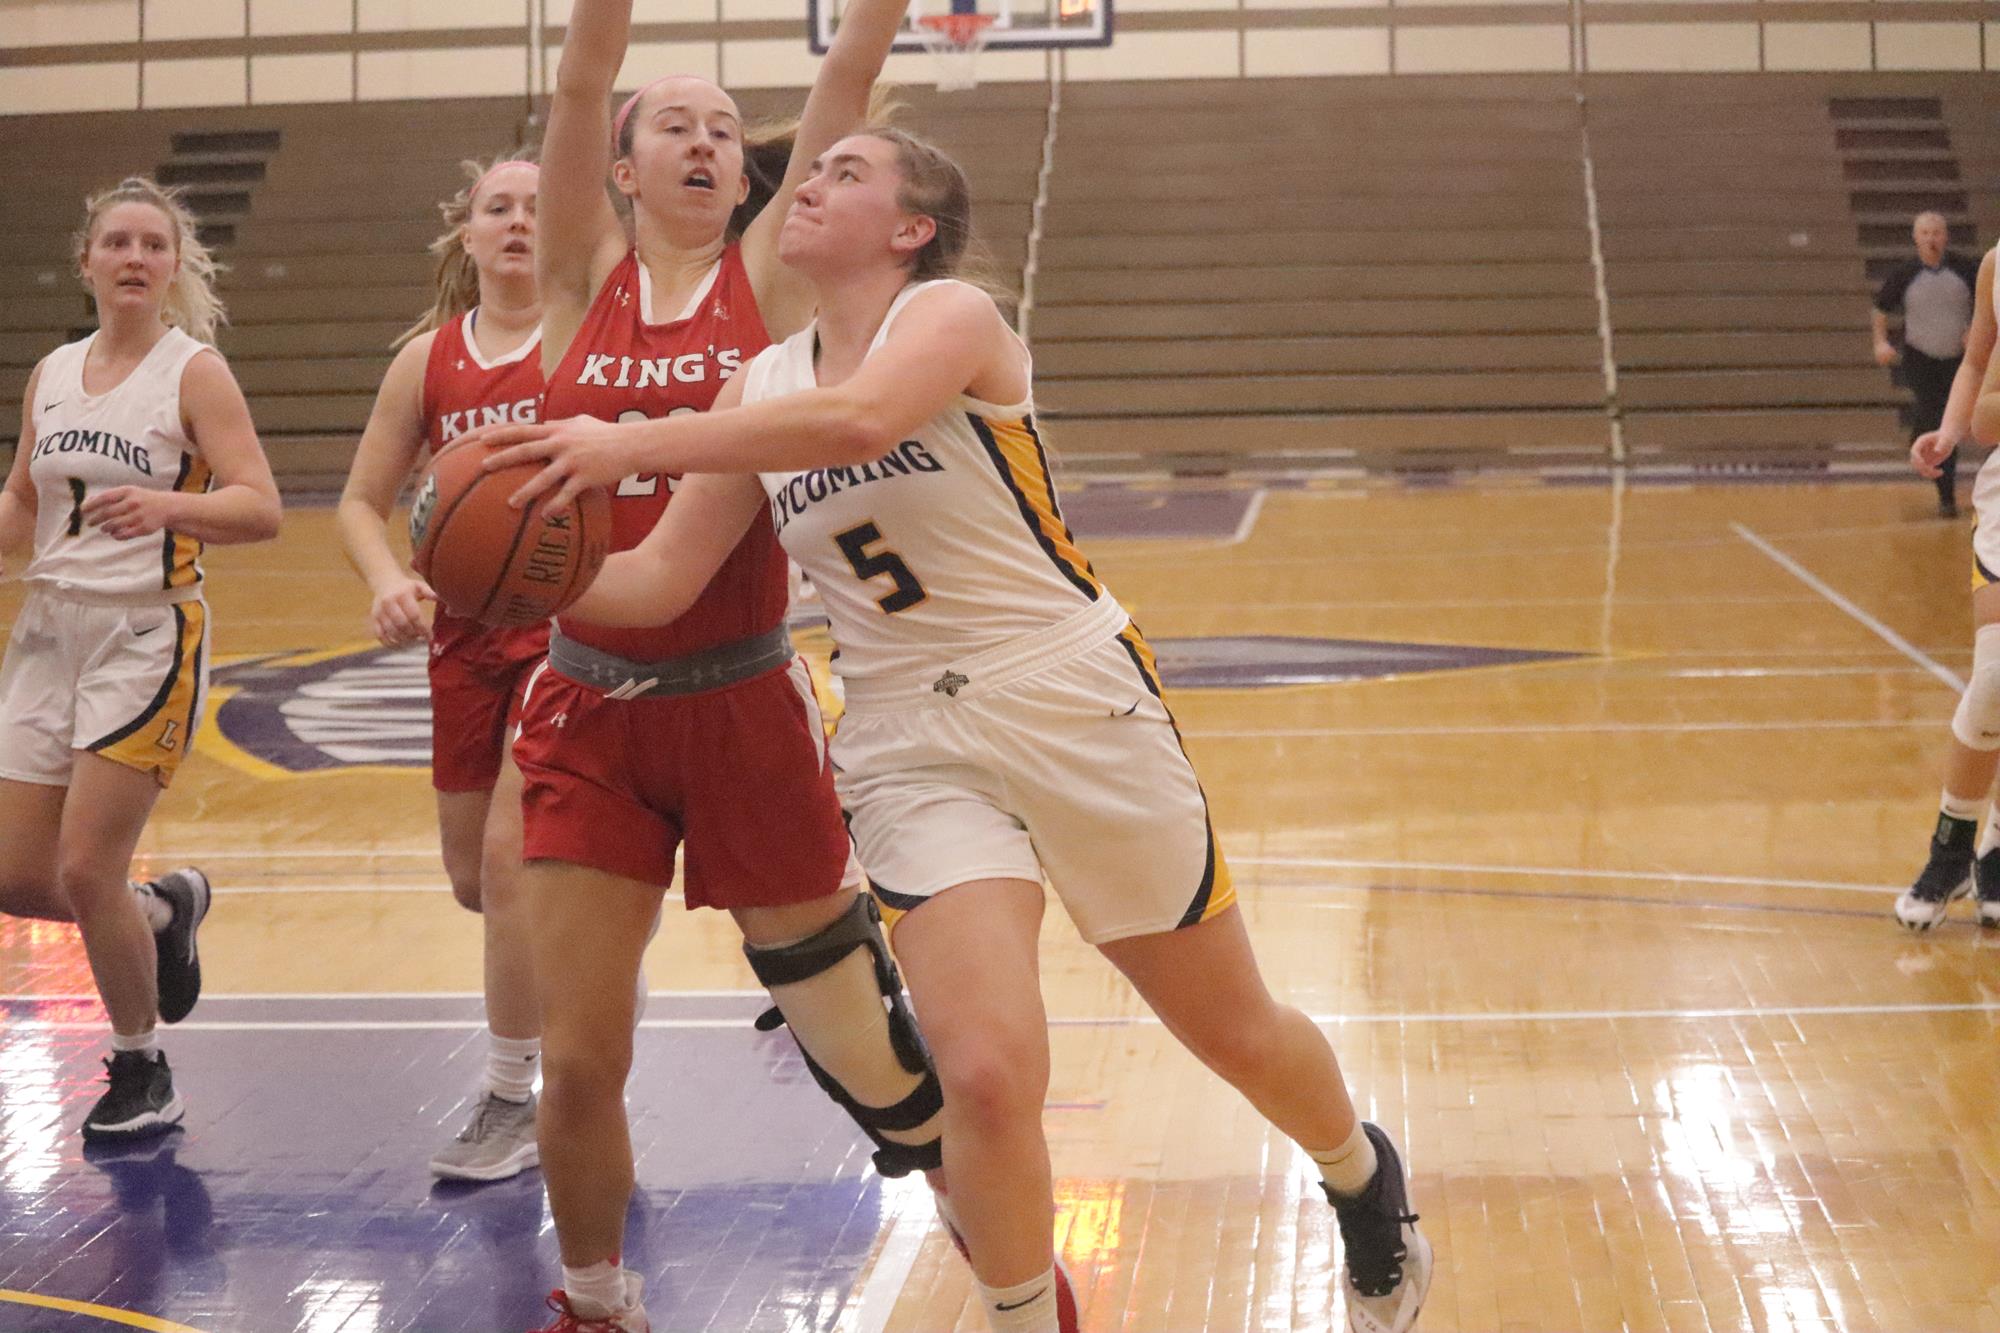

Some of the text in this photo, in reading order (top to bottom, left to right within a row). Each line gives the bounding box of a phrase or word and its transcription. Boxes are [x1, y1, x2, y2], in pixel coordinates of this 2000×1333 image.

[577, 344, 744, 389] KING'S
[440, 393, 545, 442] KING'
[32, 430, 153, 476] YCOMING
[65, 475, 86, 538] 1
[522, 514, 571, 585] ROCK
[831, 517, 928, 616] 5
[155, 719, 178, 752] L
